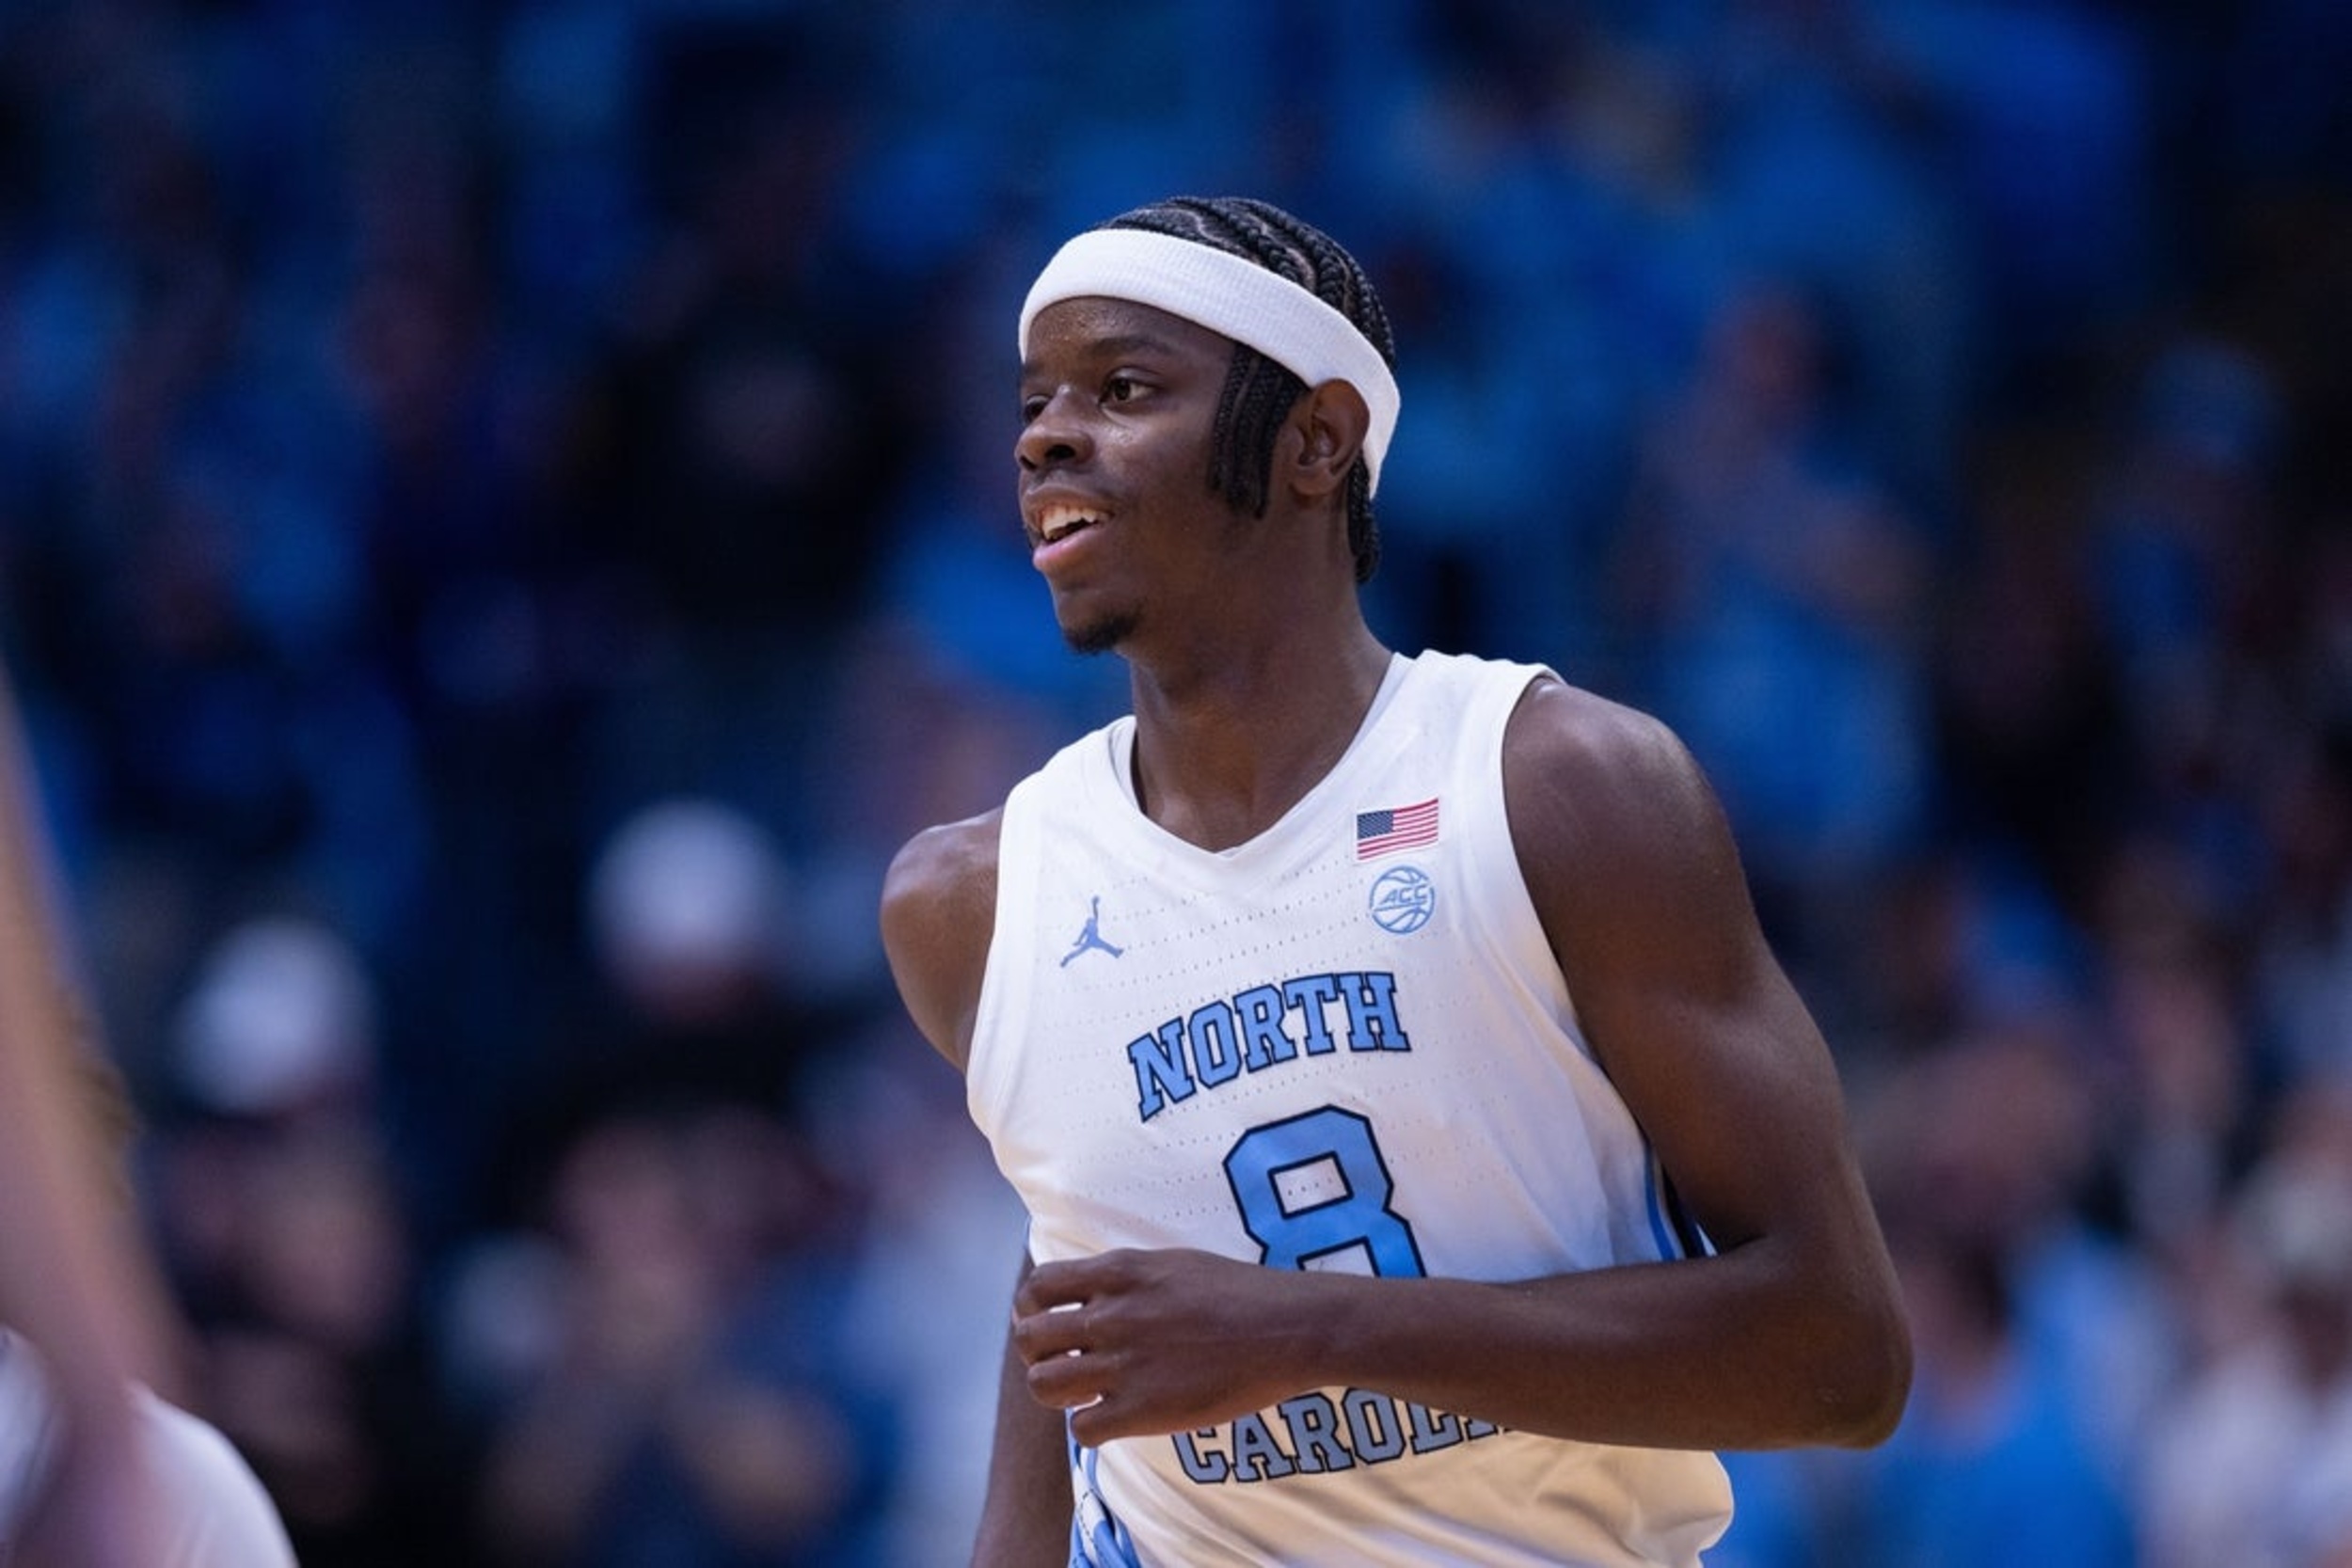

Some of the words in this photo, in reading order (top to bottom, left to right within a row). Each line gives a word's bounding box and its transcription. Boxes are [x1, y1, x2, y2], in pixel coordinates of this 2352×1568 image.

[1379, 883, 1428, 905] ACC
[1127, 971, 1412, 1123] NORTH
[1223, 1103, 1427, 1278] 8
[1171, 1386, 1511, 1484] CAROL
